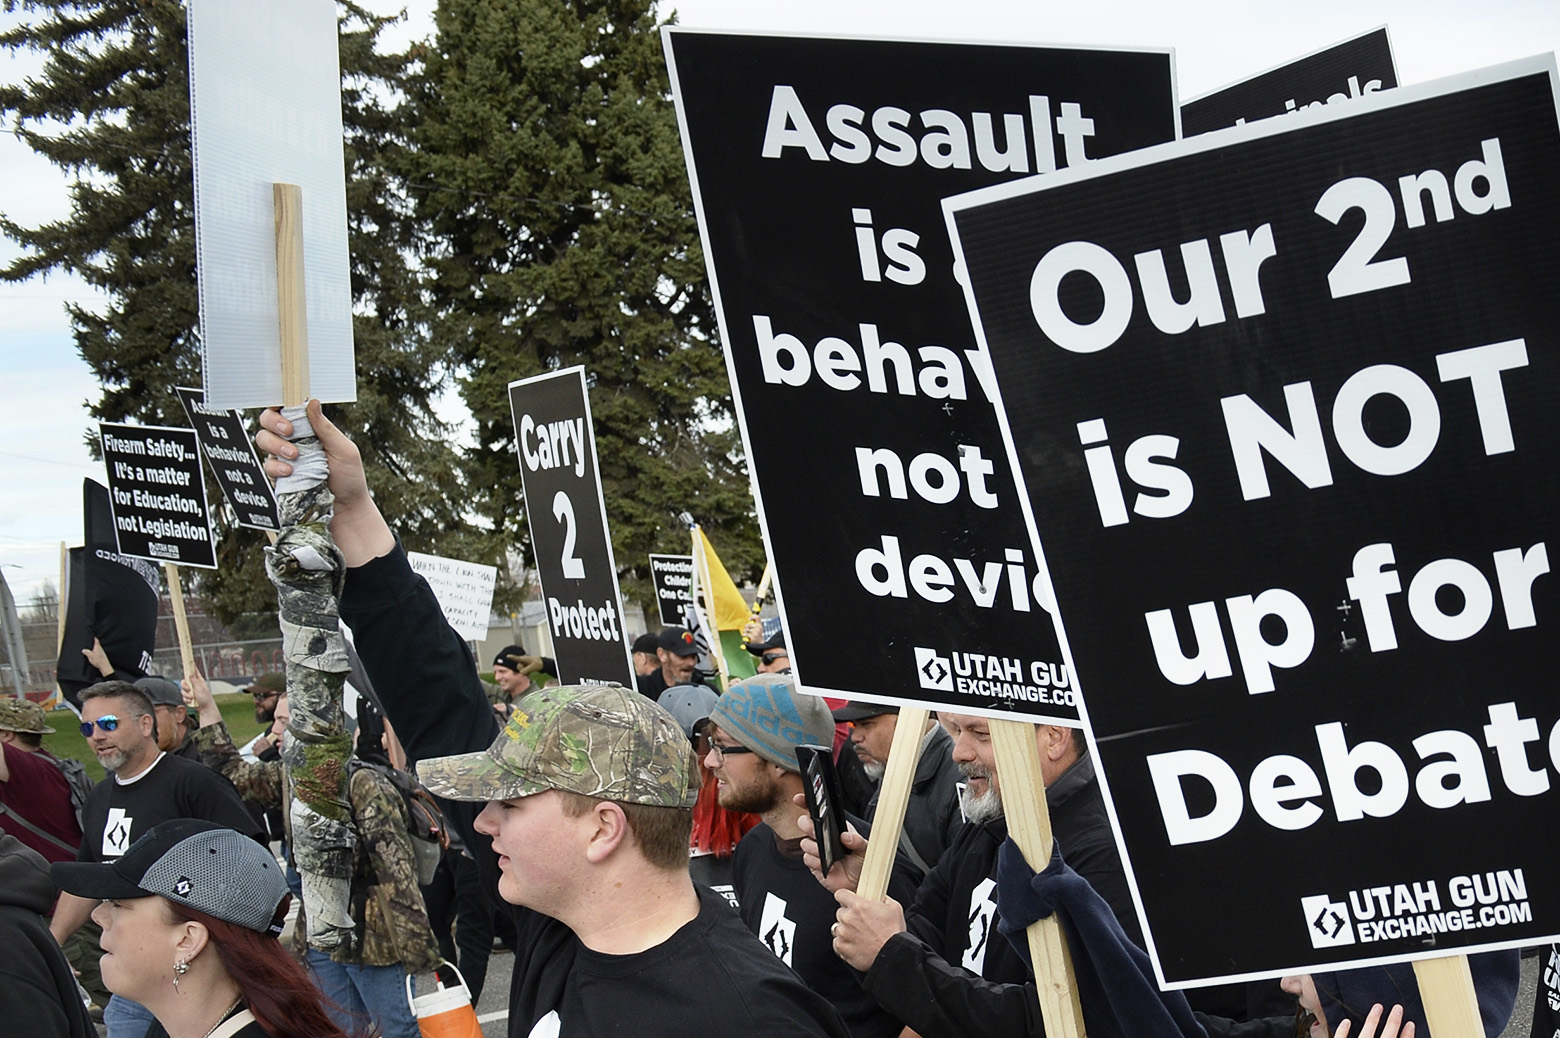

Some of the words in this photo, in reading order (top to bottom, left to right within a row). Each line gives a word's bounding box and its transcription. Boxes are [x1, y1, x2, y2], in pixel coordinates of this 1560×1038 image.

[762, 85, 1097, 173] Assault
[852, 208, 926, 285] is
[1030, 223, 1277, 353] Our
[1314, 138, 1511, 299] 2nd
[104, 434, 145, 455] Firearm
[146, 438, 195, 462] Safety...
[207, 422, 219, 438] is
[220, 427, 229, 439] a
[521, 413, 584, 478] Carry
[1076, 418, 1194, 527] is
[1220, 338, 1529, 501] NOT
[115, 462, 134, 479] It's
[136, 468, 144, 481] a
[147, 469, 190, 486] matter
[204, 443, 256, 467] behavior,
[225, 469, 242, 483] not
[244, 473, 253, 485] a
[855, 444, 998, 509] not
[114, 487, 131, 504] for
[132, 490, 202, 517] Education,
[233, 488, 268, 508] device
[118, 516, 137, 531] not
[138, 516, 208, 541] Legislation
[553, 491, 585, 579] 2
[549, 597, 619, 641] Protect
[1144, 588, 1315, 695] up
[1346, 542, 1550, 652] for
[952, 652, 1023, 682] UTAH
[1030, 662, 1069, 688] GU
[956, 678, 1076, 706] EXCHANGE.CO
[1350, 880, 1442, 920] UTAH
[1449, 869, 1528, 908] GUN
[1357, 901, 1532, 943] EXCHANGE.COM
